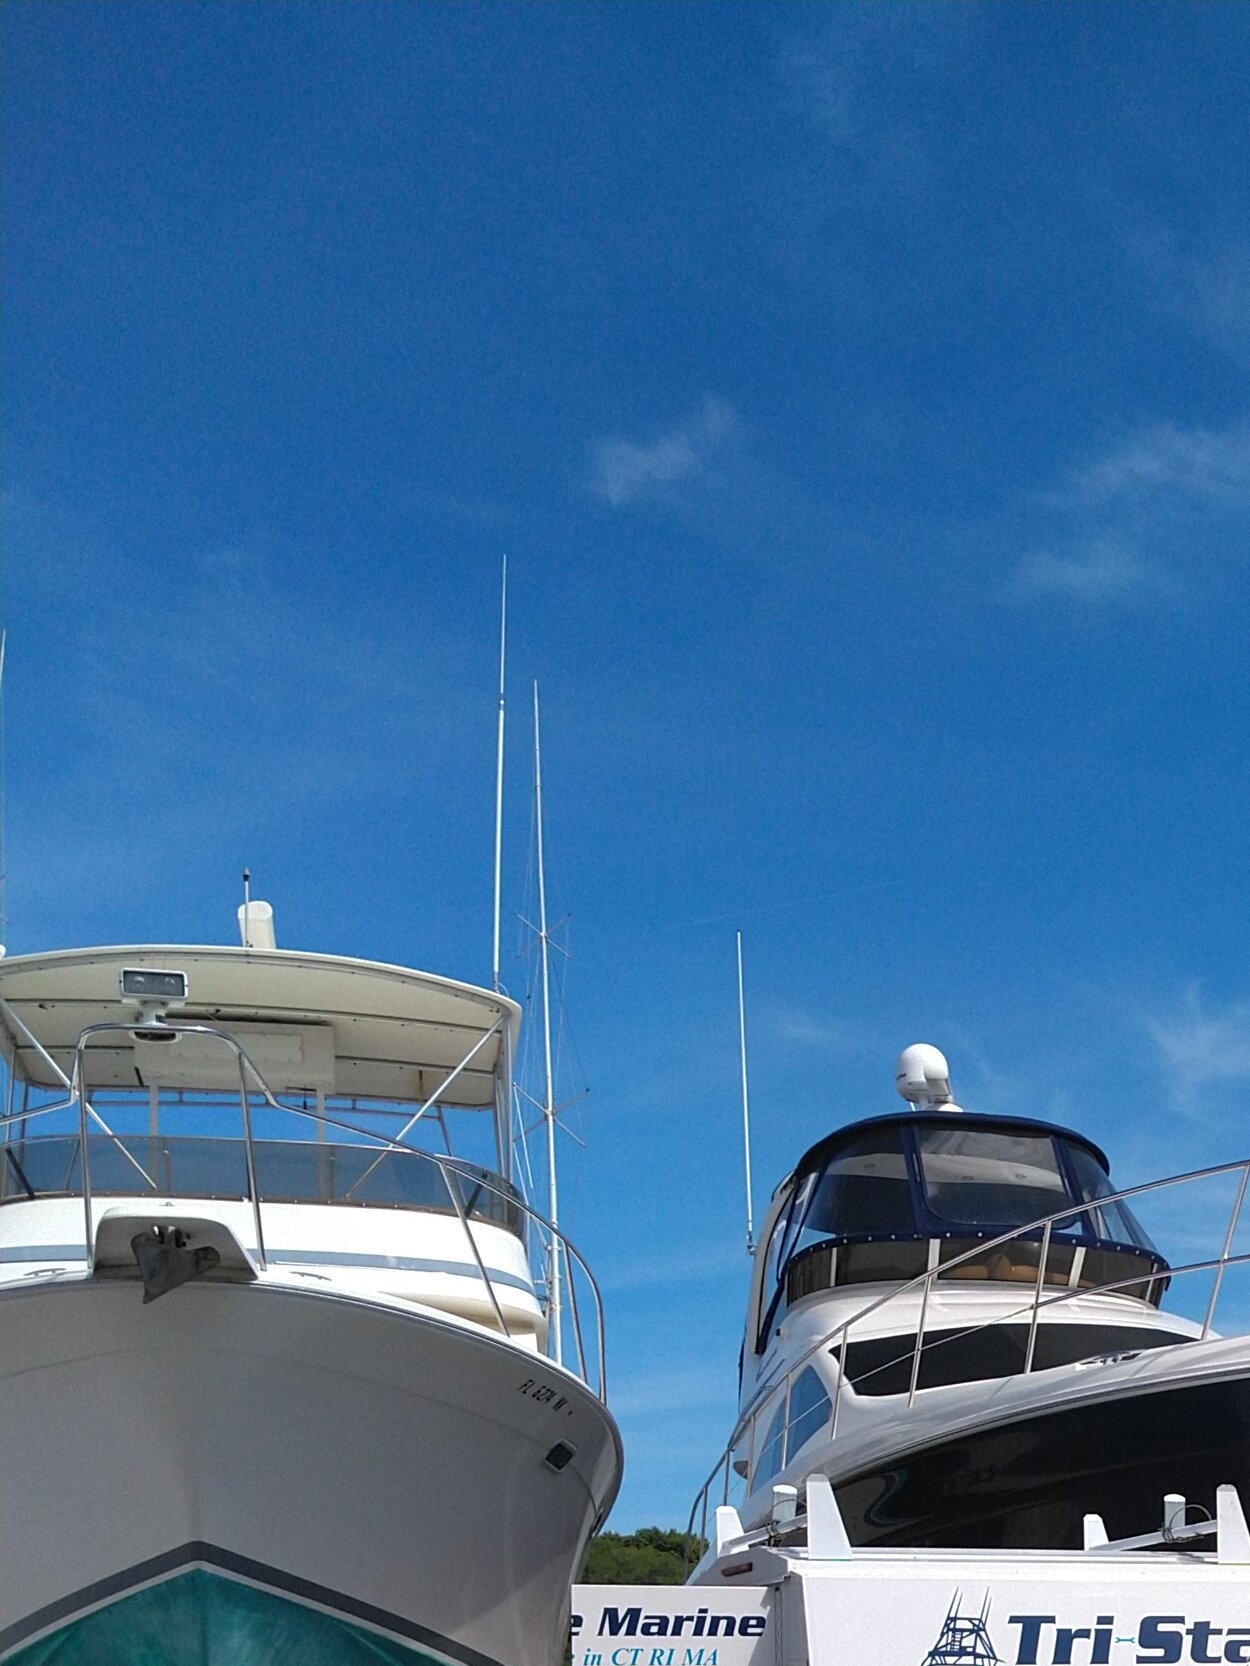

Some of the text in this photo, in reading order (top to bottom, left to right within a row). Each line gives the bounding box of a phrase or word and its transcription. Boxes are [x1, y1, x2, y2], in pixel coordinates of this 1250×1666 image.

[597, 1607, 766, 1637] Marine
[583, 1648, 718, 1666] in CT RI MA
